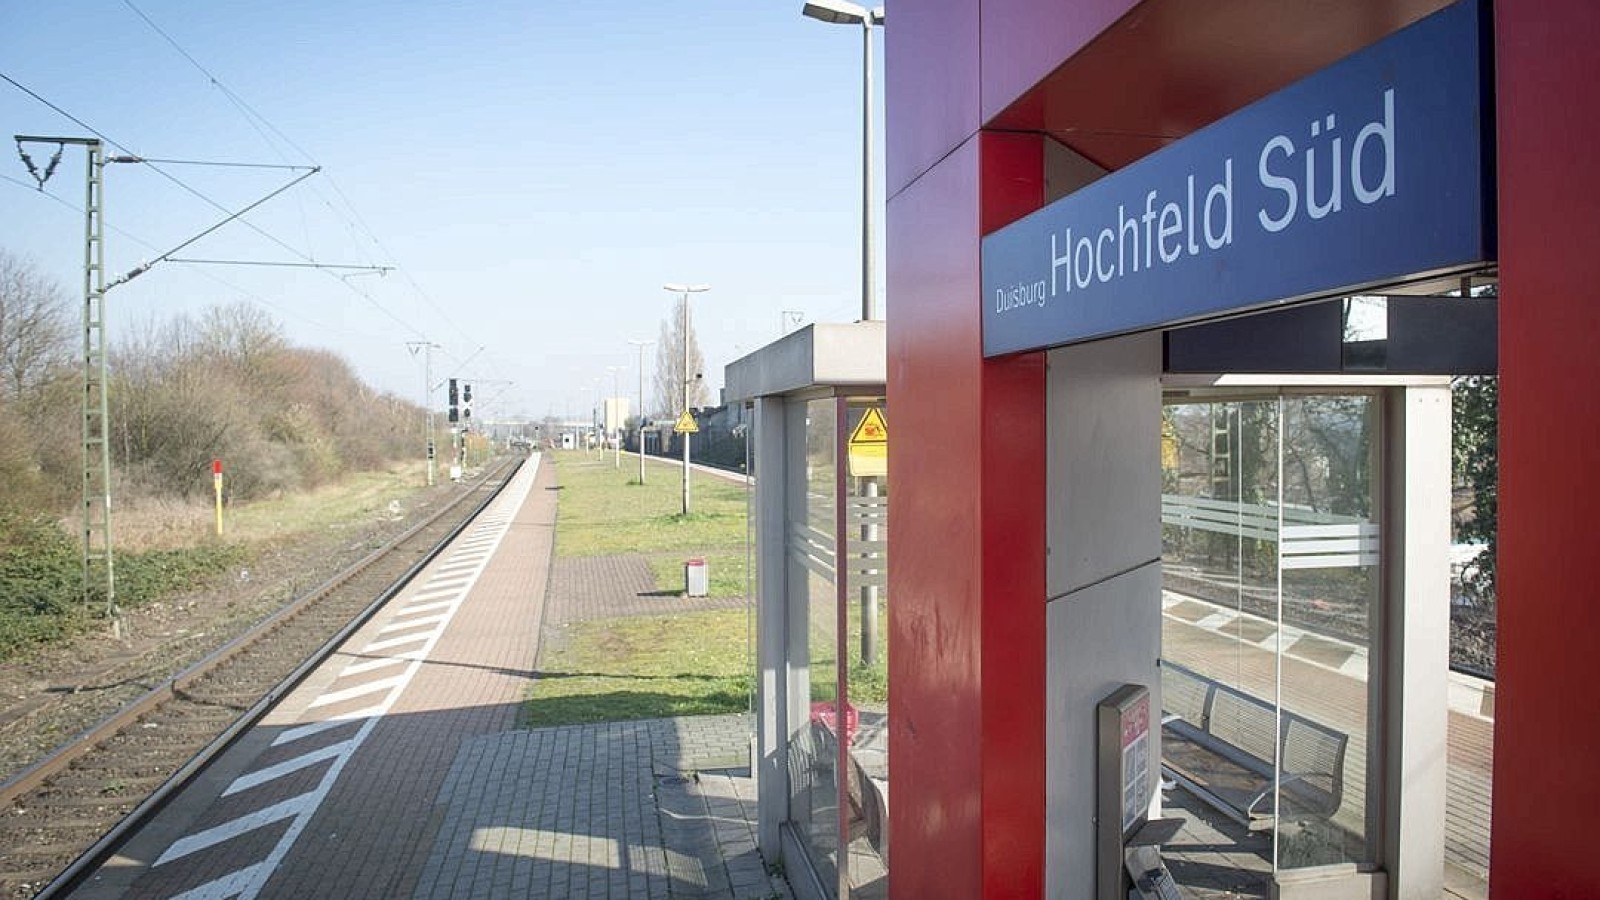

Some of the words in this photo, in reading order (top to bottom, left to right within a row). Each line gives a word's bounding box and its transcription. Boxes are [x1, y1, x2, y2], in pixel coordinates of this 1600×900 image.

[995, 279, 1046, 314] Duisburg
[1050, 158, 1233, 296] Hochfeld
[1257, 88, 1396, 234] Süd
